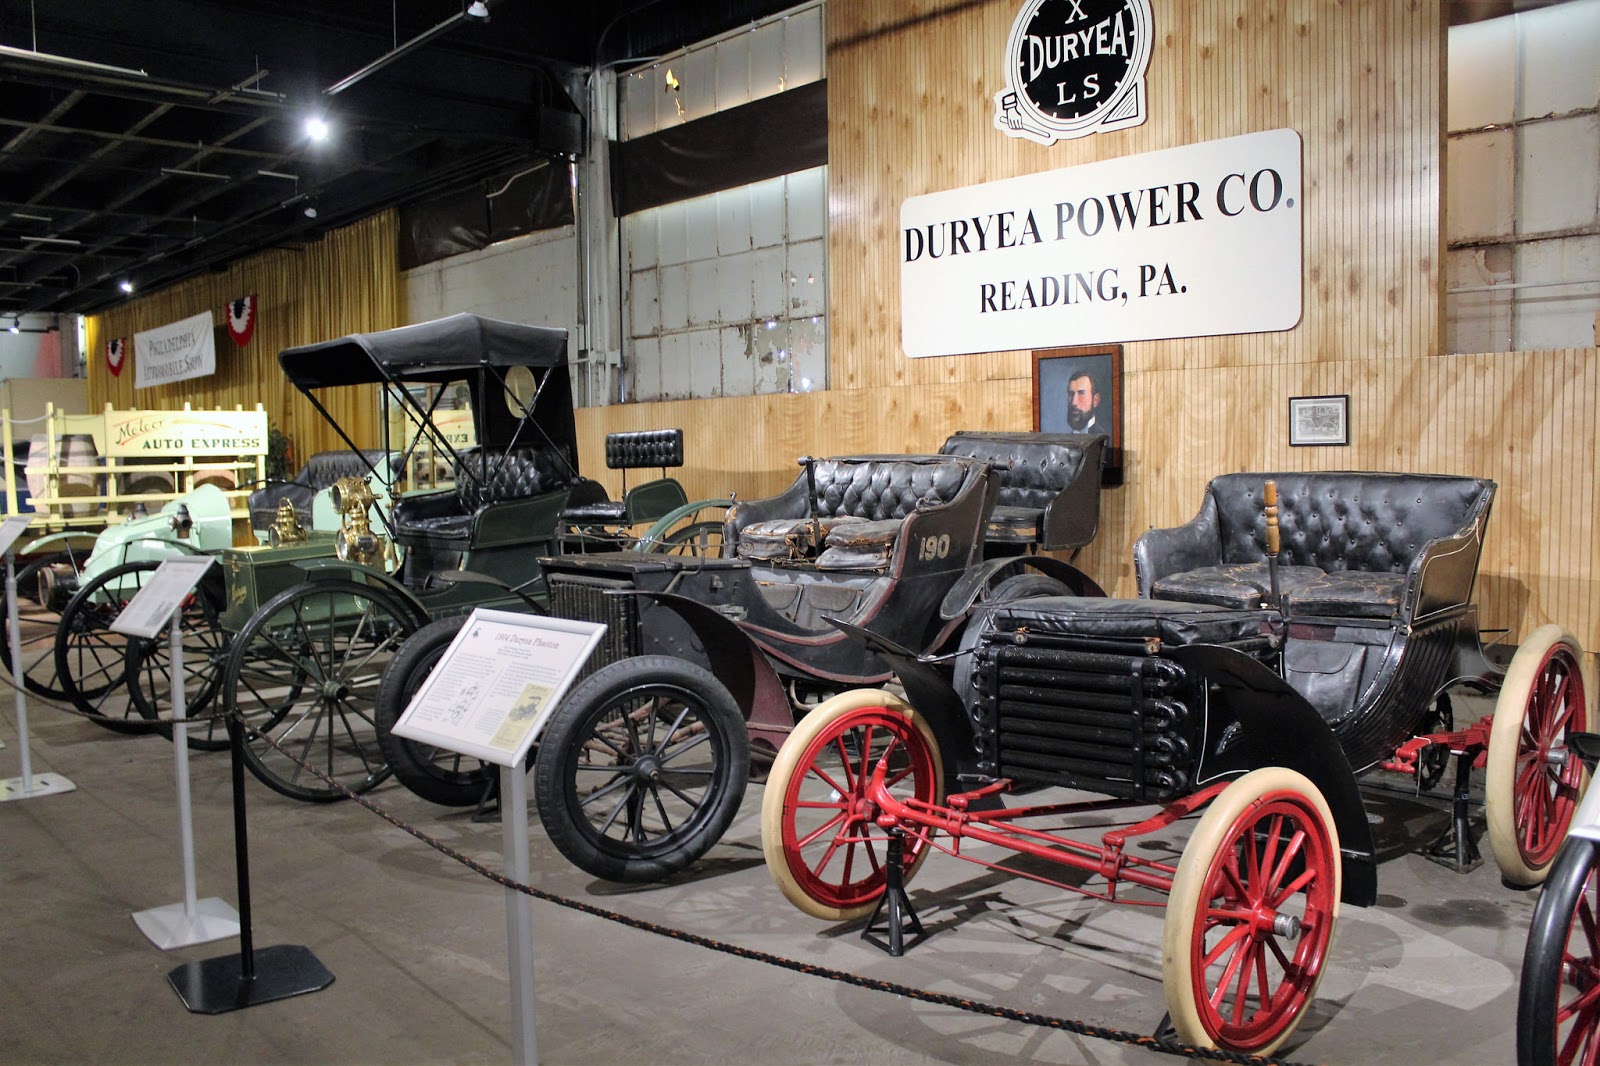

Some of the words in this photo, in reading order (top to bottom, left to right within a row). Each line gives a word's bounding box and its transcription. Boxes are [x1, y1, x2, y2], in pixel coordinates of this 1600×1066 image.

[1028, 10, 1128, 82] DURYEA
[903, 211, 1044, 263] DURYEA
[1055, 181, 1204, 241] POWER
[1216, 168, 1295, 217] CO.
[979, 267, 1128, 314] READING,
[1137, 262, 1187, 298] PA.
[143, 439, 183, 450] AUTO
[191, 438, 260, 449] EXPRESS
[919, 533, 950, 561] 190
